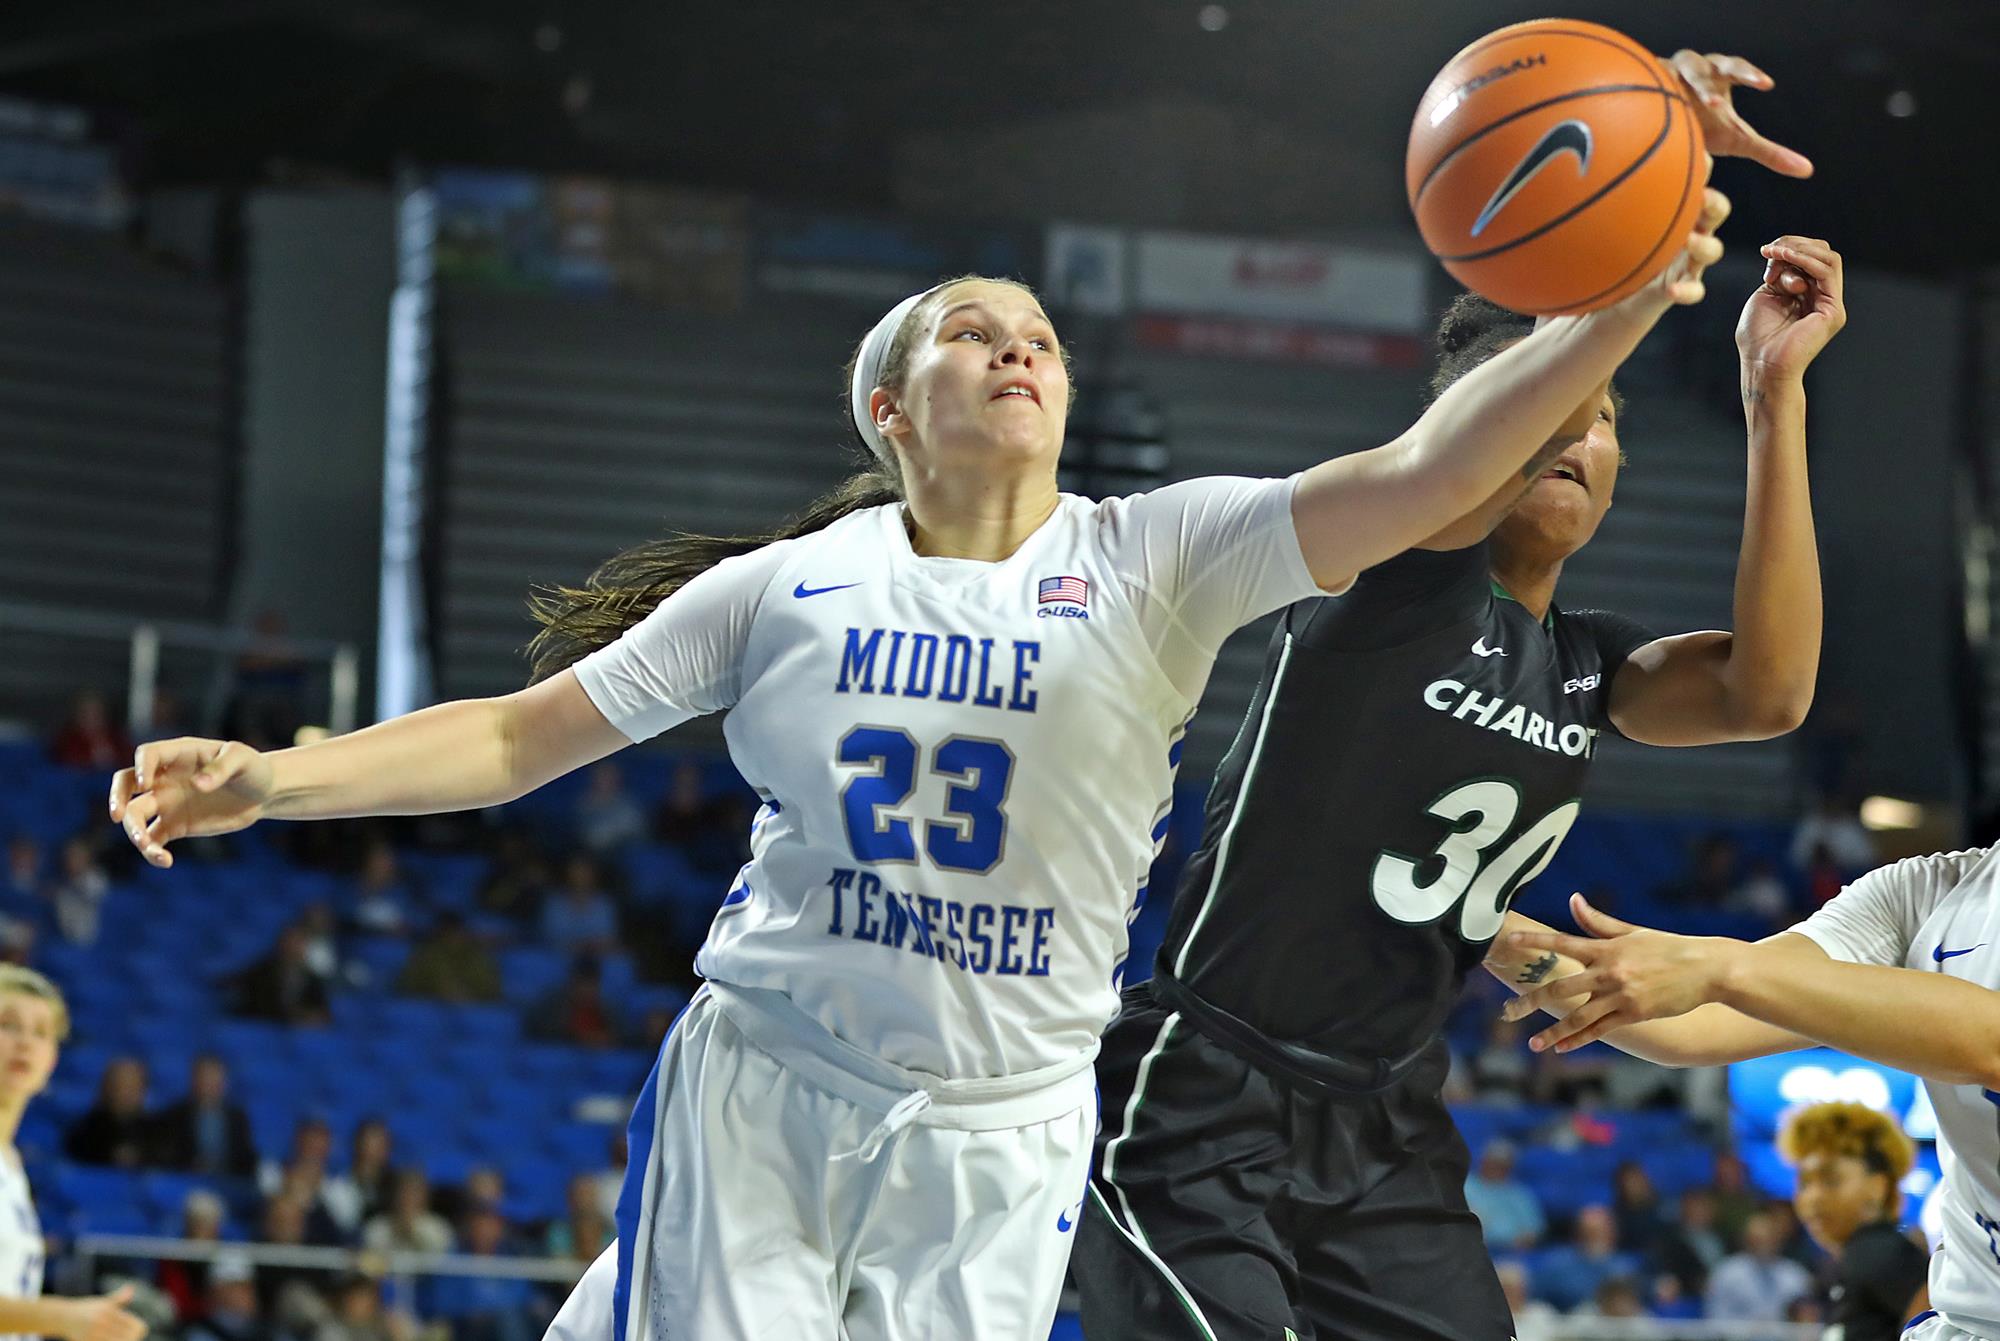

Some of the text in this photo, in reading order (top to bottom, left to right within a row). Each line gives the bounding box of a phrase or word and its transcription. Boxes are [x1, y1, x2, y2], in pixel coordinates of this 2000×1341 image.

[834, 627, 1041, 713] MIDDLE
[1423, 679, 1600, 759] CHARLOT
[834, 722, 1017, 877] 23
[1370, 777, 1581, 943] 30
